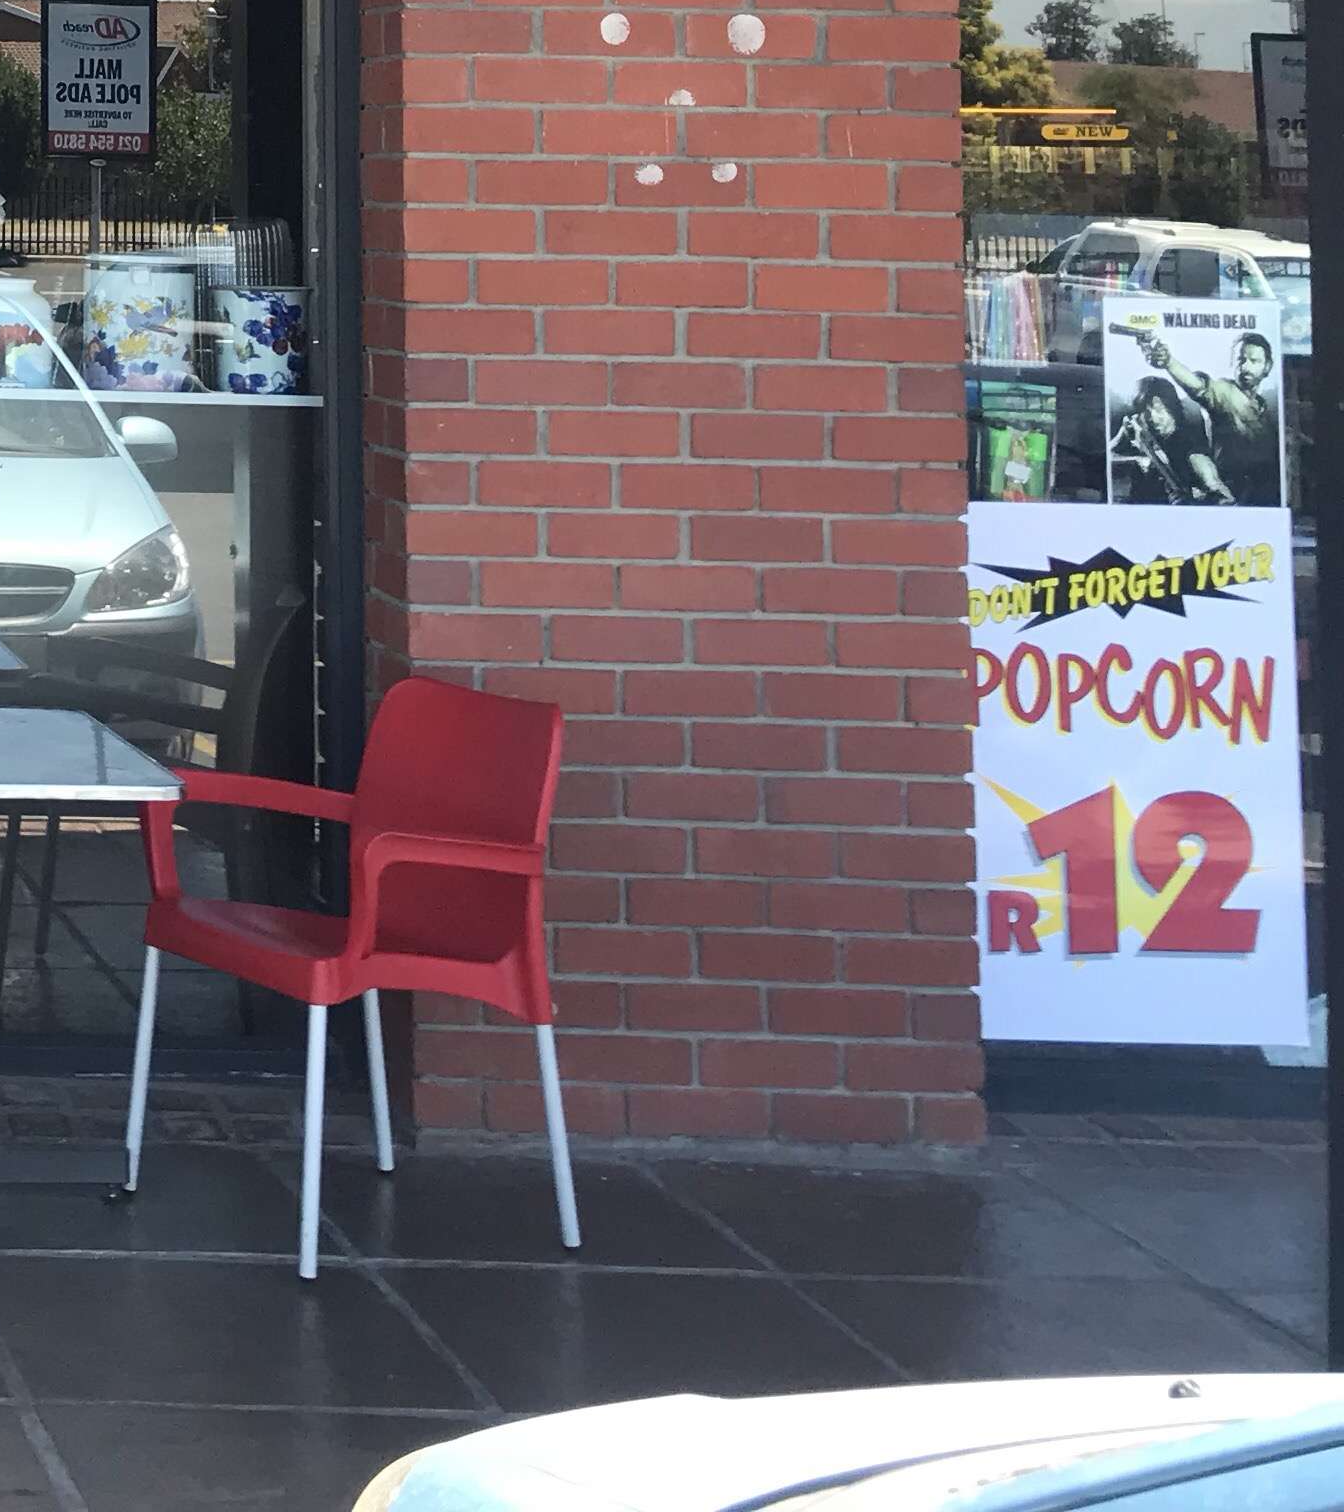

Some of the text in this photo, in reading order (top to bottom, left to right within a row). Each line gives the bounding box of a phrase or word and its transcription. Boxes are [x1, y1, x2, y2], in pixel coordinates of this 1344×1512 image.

[1075, 126, 1113, 138] NEW
[1163, 312, 1221, 329] WALKING
[1223, 314, 1257, 330] DEAD
[968, 542, 1275, 627] DON'T FORGET YOUR
[968, 641, 1277, 746] POPCORN
